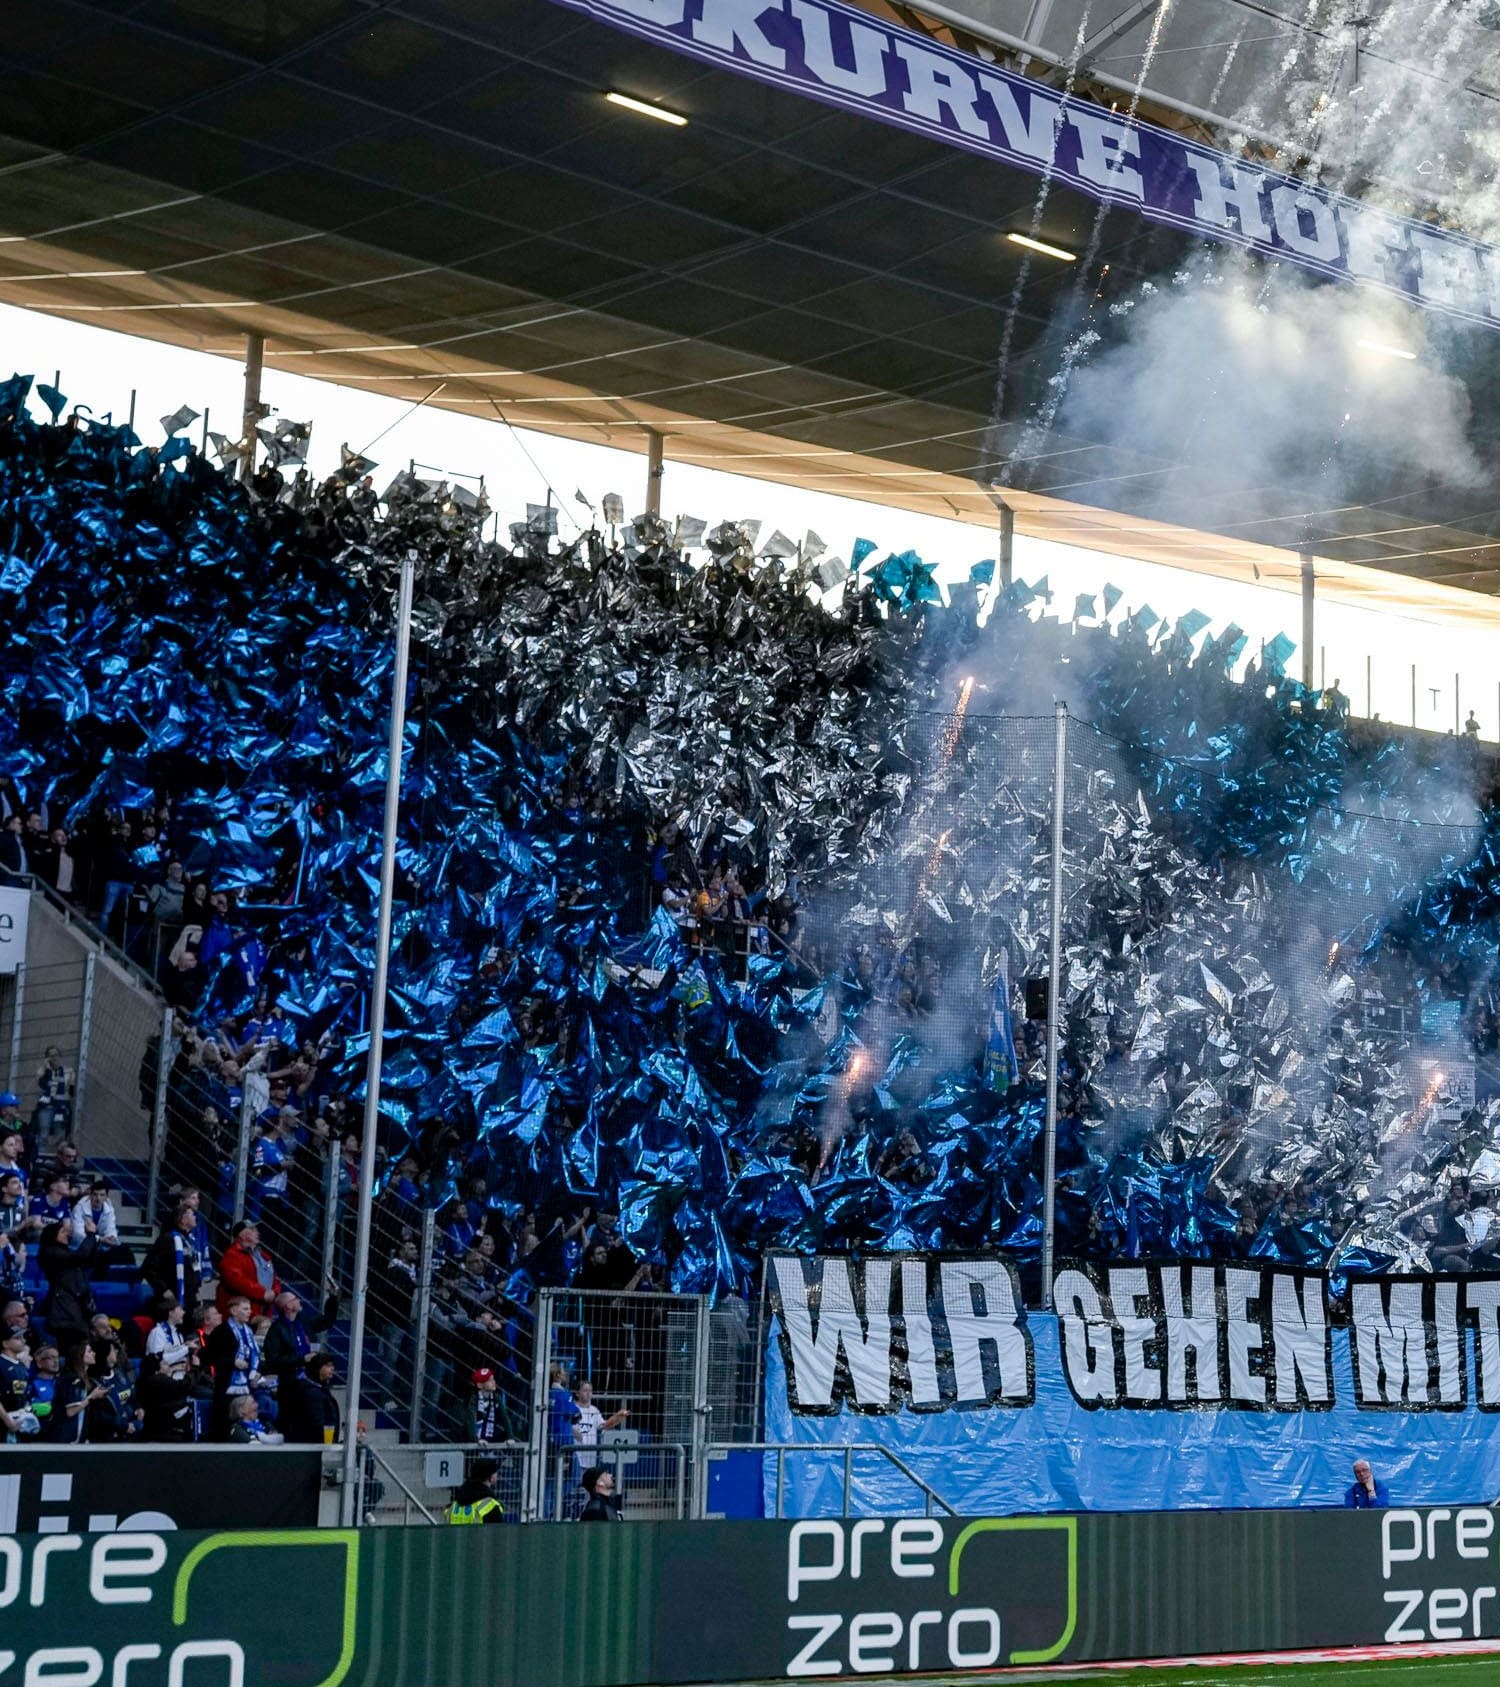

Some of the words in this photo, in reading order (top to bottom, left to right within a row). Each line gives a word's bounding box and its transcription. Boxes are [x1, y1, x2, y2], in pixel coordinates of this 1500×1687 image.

[597, 0, 1145, 194] KURVE
[773, 1256, 1029, 1406] WIR
[1052, 1266, 1330, 1403] GEHEN
[439, 1463, 449, 1477] R
[787, 1519, 943, 1602] pre
[1381, 1509, 1495, 1580] pre
[0, 1639, 245, 1687] ero
[786, 1607, 1001, 1677] zero
